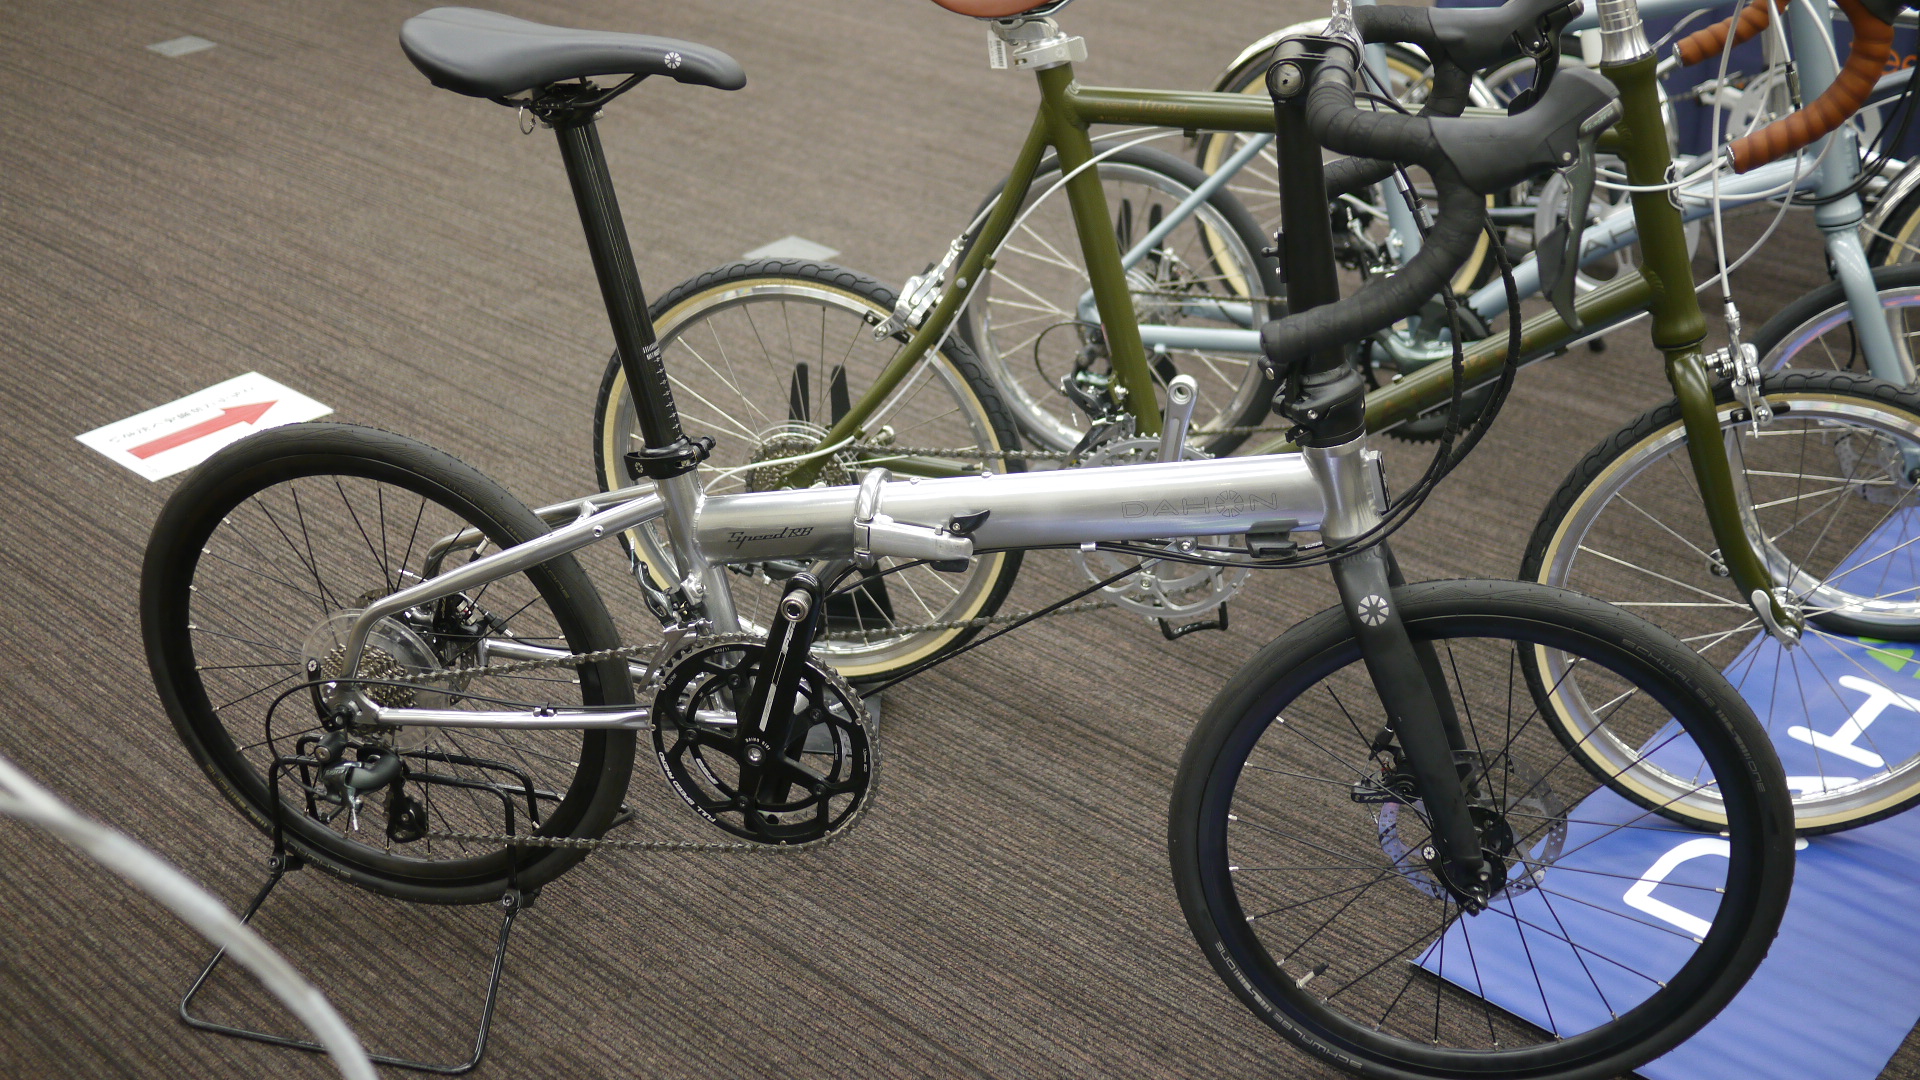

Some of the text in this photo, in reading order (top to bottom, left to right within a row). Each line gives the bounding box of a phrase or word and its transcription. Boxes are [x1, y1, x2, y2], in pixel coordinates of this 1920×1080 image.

[1122, 490, 1278, 518] DAHON
[727, 526, 789, 550] Speed
[697, 805, 716, 823] FULL
[1215, 941, 1363, 1069] SCHWALBE ONE
